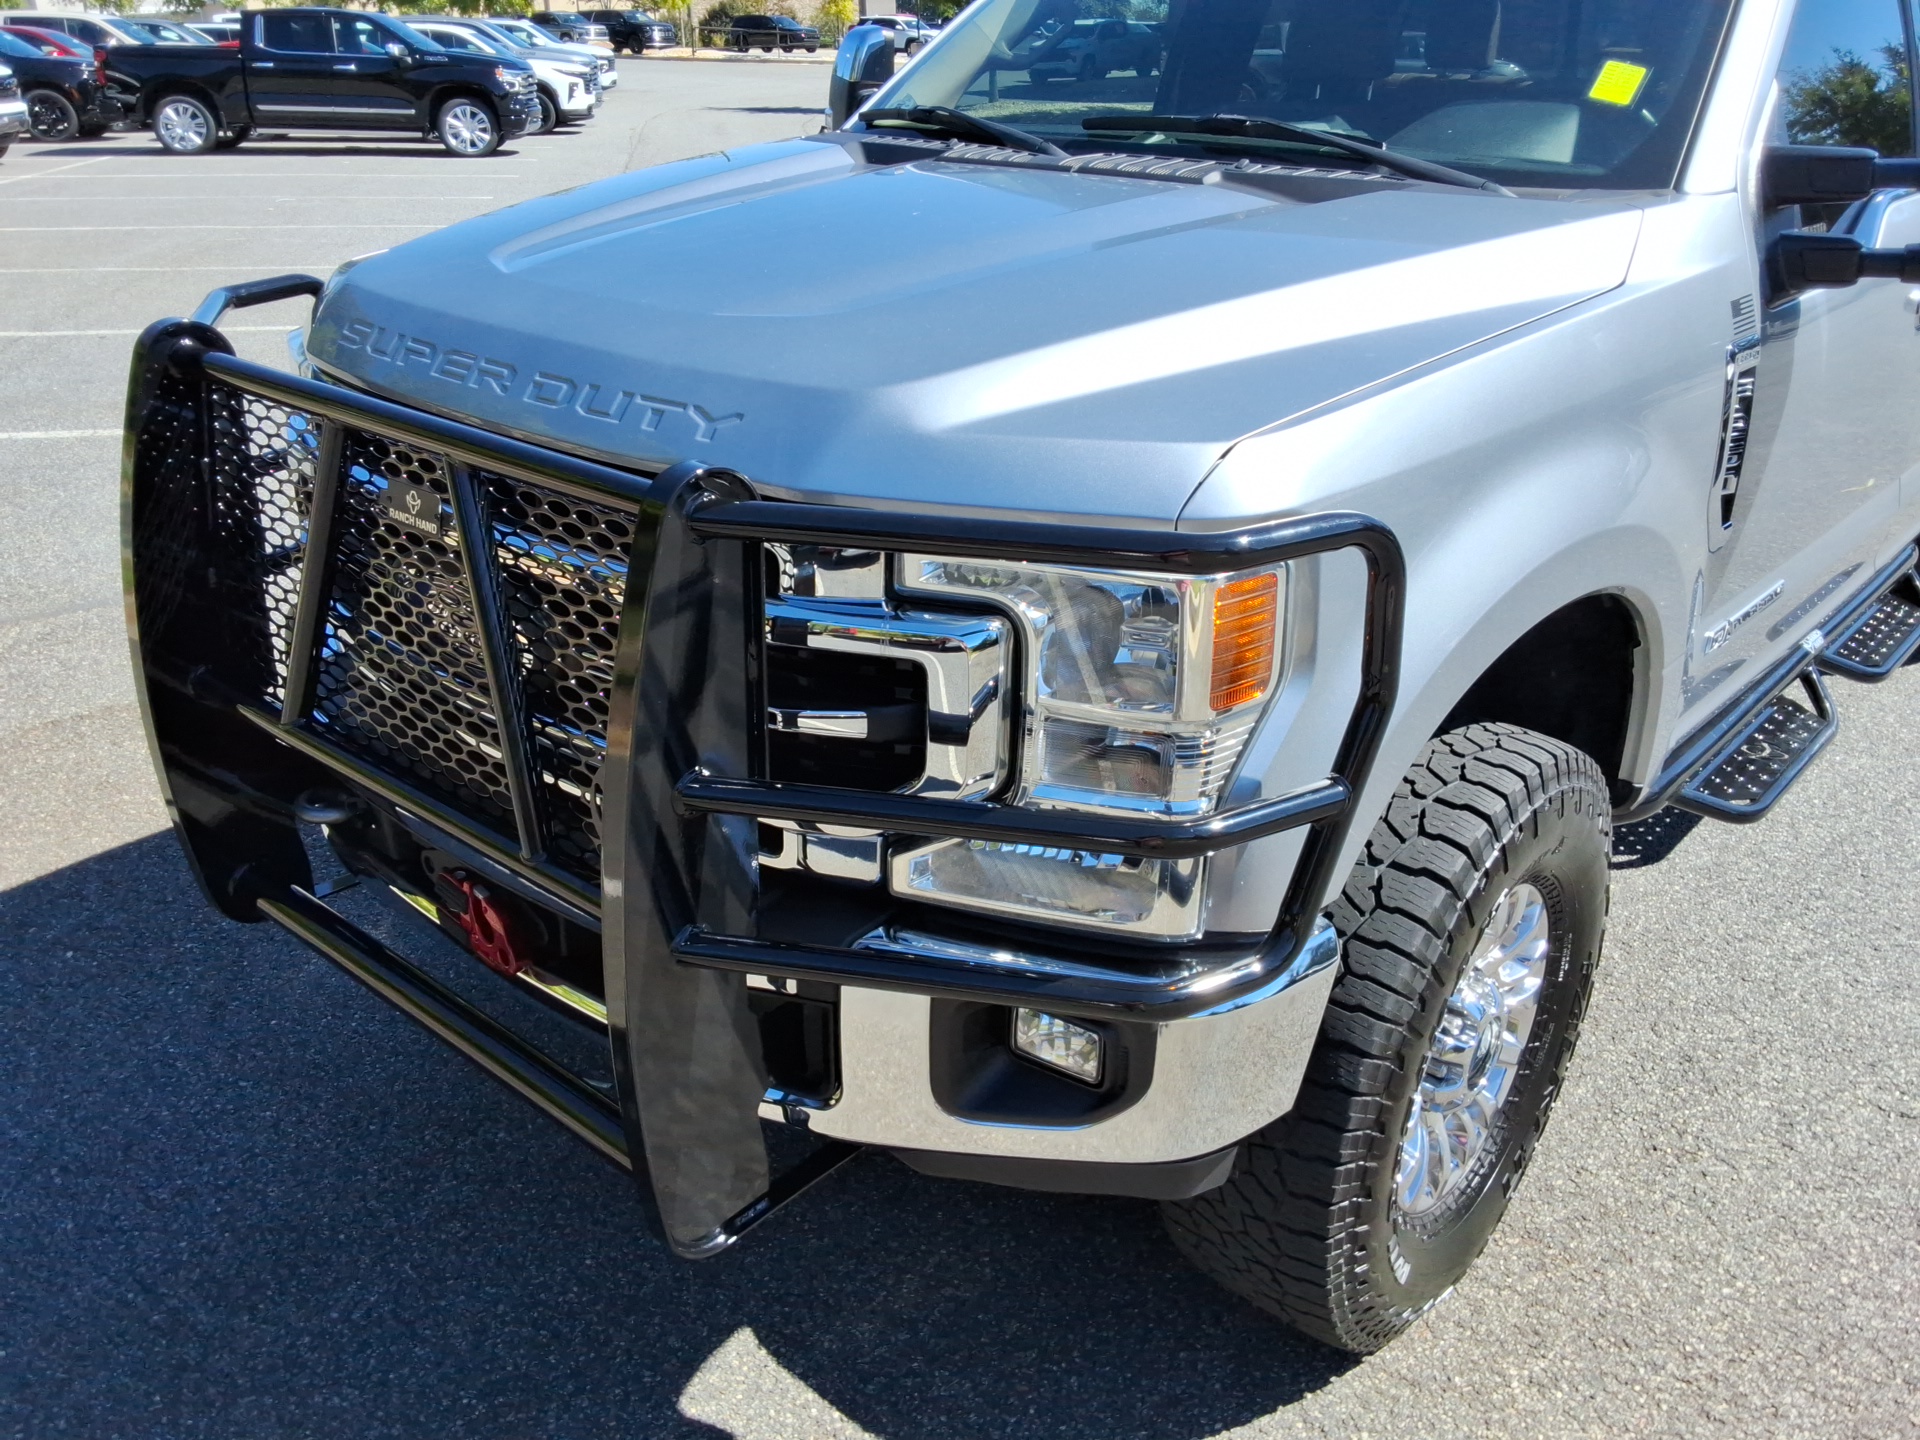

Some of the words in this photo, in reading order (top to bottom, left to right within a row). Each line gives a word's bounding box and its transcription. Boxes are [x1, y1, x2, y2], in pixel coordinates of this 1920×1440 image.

[337, 317, 518, 396] SUPER
[523, 370, 745, 442] DUTY
[389, 507, 415, 526] RANCH
[415, 517, 438, 534] HAND
